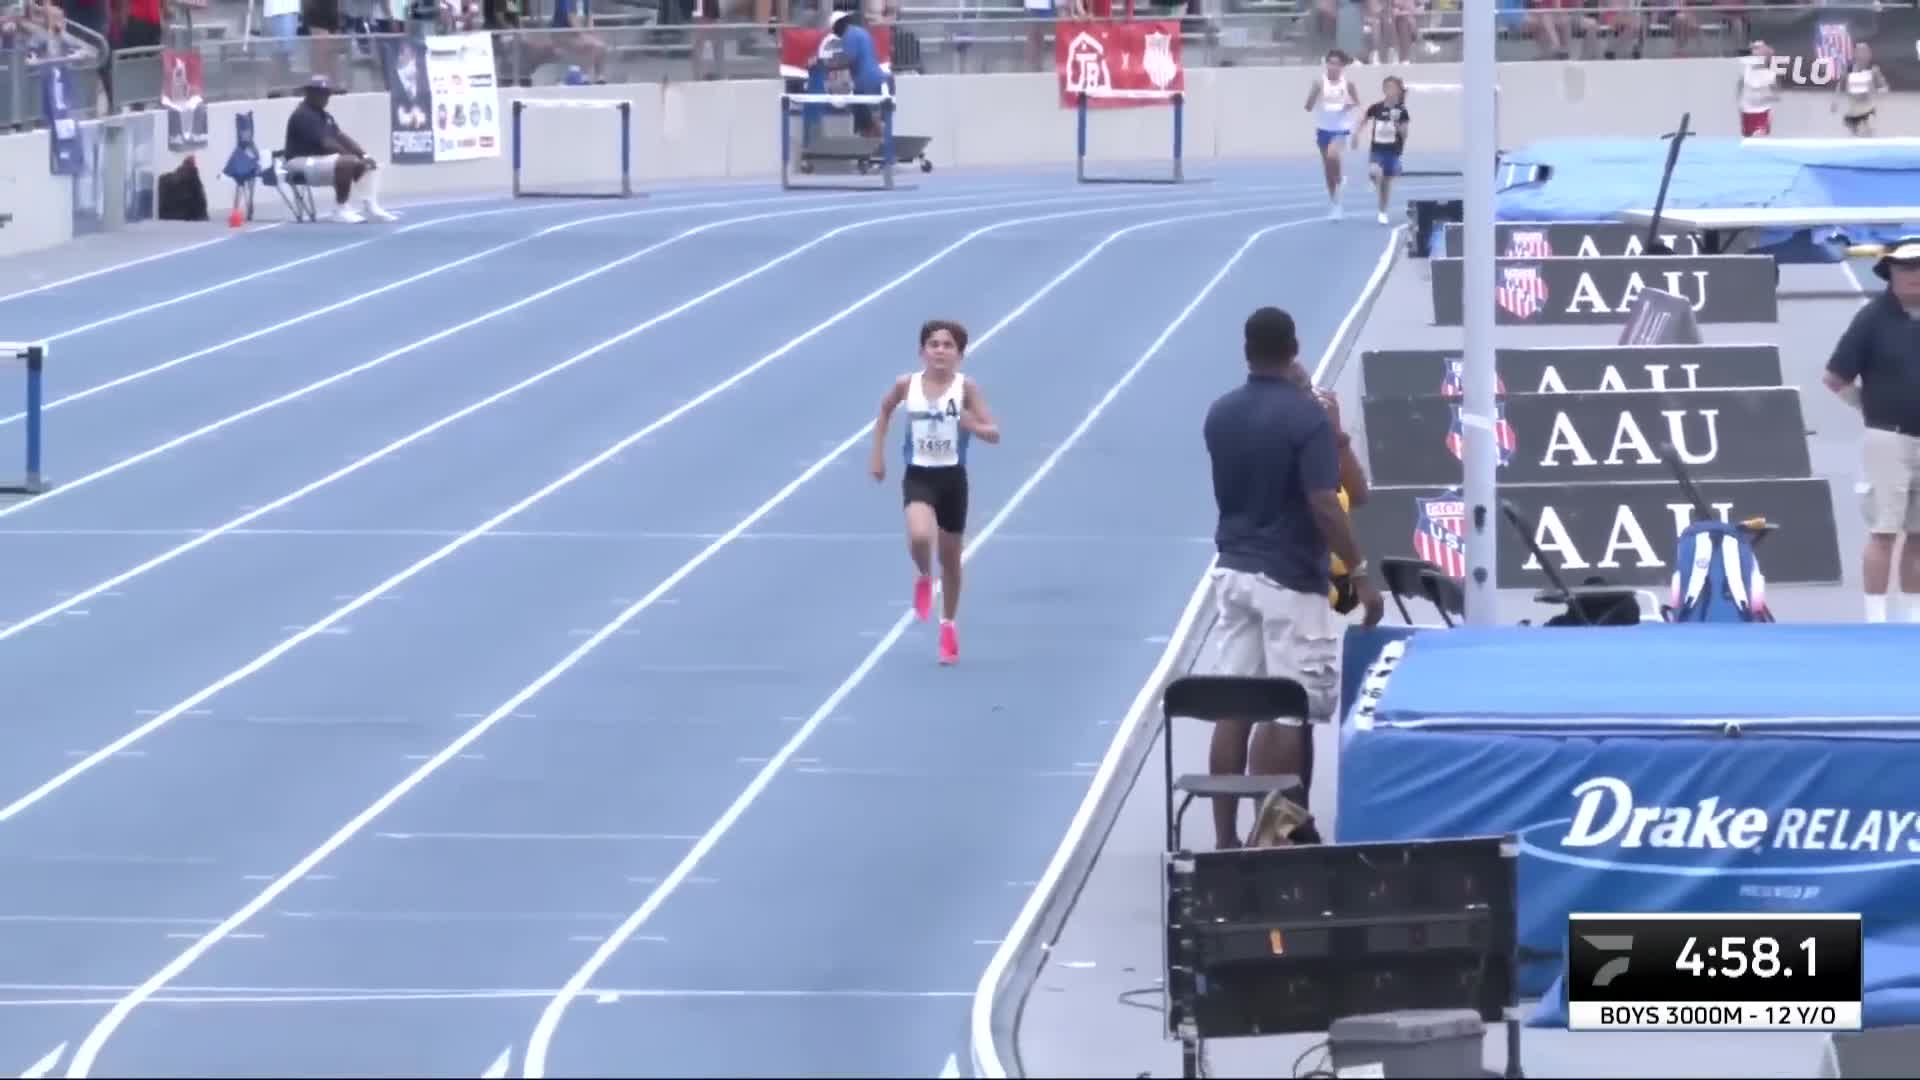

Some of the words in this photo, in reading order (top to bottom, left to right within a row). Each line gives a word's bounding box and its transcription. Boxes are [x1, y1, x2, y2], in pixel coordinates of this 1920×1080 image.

[1539, 409, 1720, 467] AAU
[1429, 520, 1465, 554] US
[1560, 777, 1769, 849] Drake
